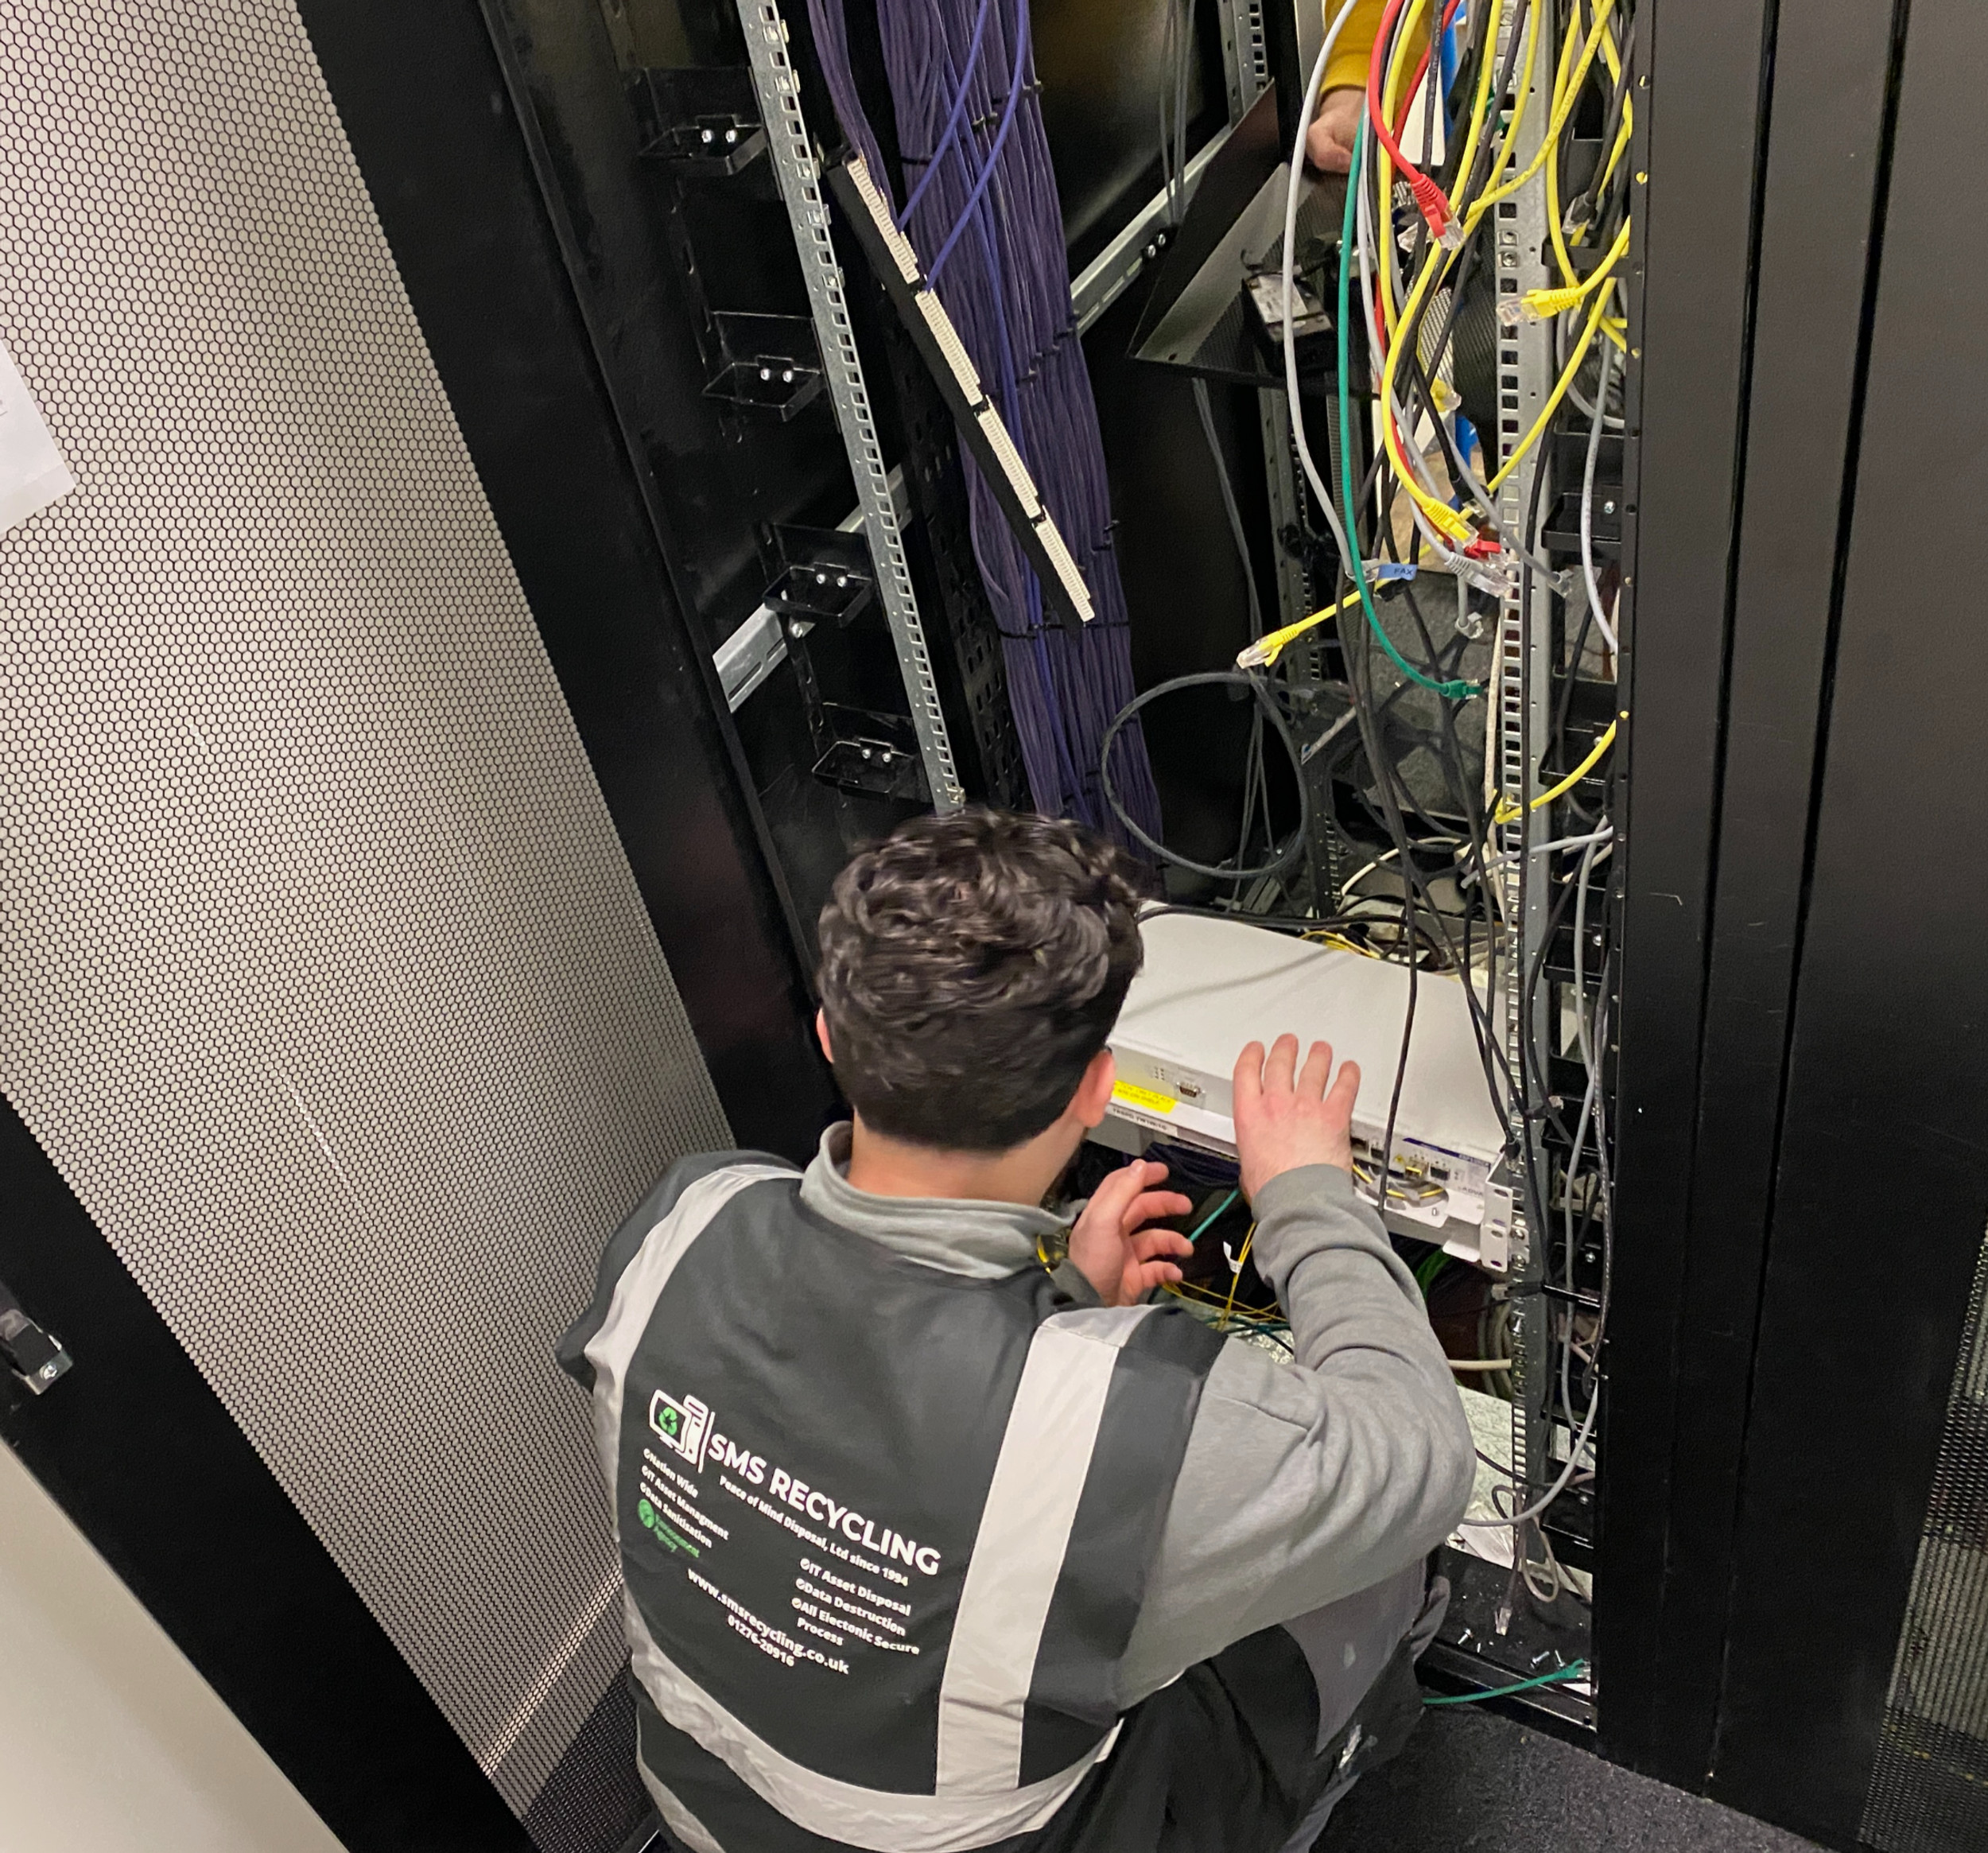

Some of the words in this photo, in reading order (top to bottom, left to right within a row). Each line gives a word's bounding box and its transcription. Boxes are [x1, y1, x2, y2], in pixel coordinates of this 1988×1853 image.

[645, 1487, 662, 1509] Data
[650, 1452, 676, 1482] Nation
[677, 1474, 699, 1498] Wide
[654, 1478, 677, 1501] Asset
[708, 1433, 767, 1485] SMS
[769, 1467, 942, 1575] RECYCLING
[719, 1475, 747, 1501] Peace
[747, 1495, 760, 1507] of
[758, 1500, 784, 1524] Mind
[829, 1542, 849, 1561] Ltd
[850, 1552, 880, 1575] since
[882, 1567, 908, 1587] 1994
[803, 1582, 833, 1604] Data
[834, 1596, 906, 1637] Destruction
[809, 1564, 822, 1576] IT
[821, 1571, 856, 1594] Asset
[857, 1586, 911, 1616] Disposal
[687, 1567, 849, 1676] www.smsrecycling.co.uk
[797, 1617, 845, 1646] Process
[801, 1602, 817, 1617] All
[874, 1635, 920, 1655] Secure
